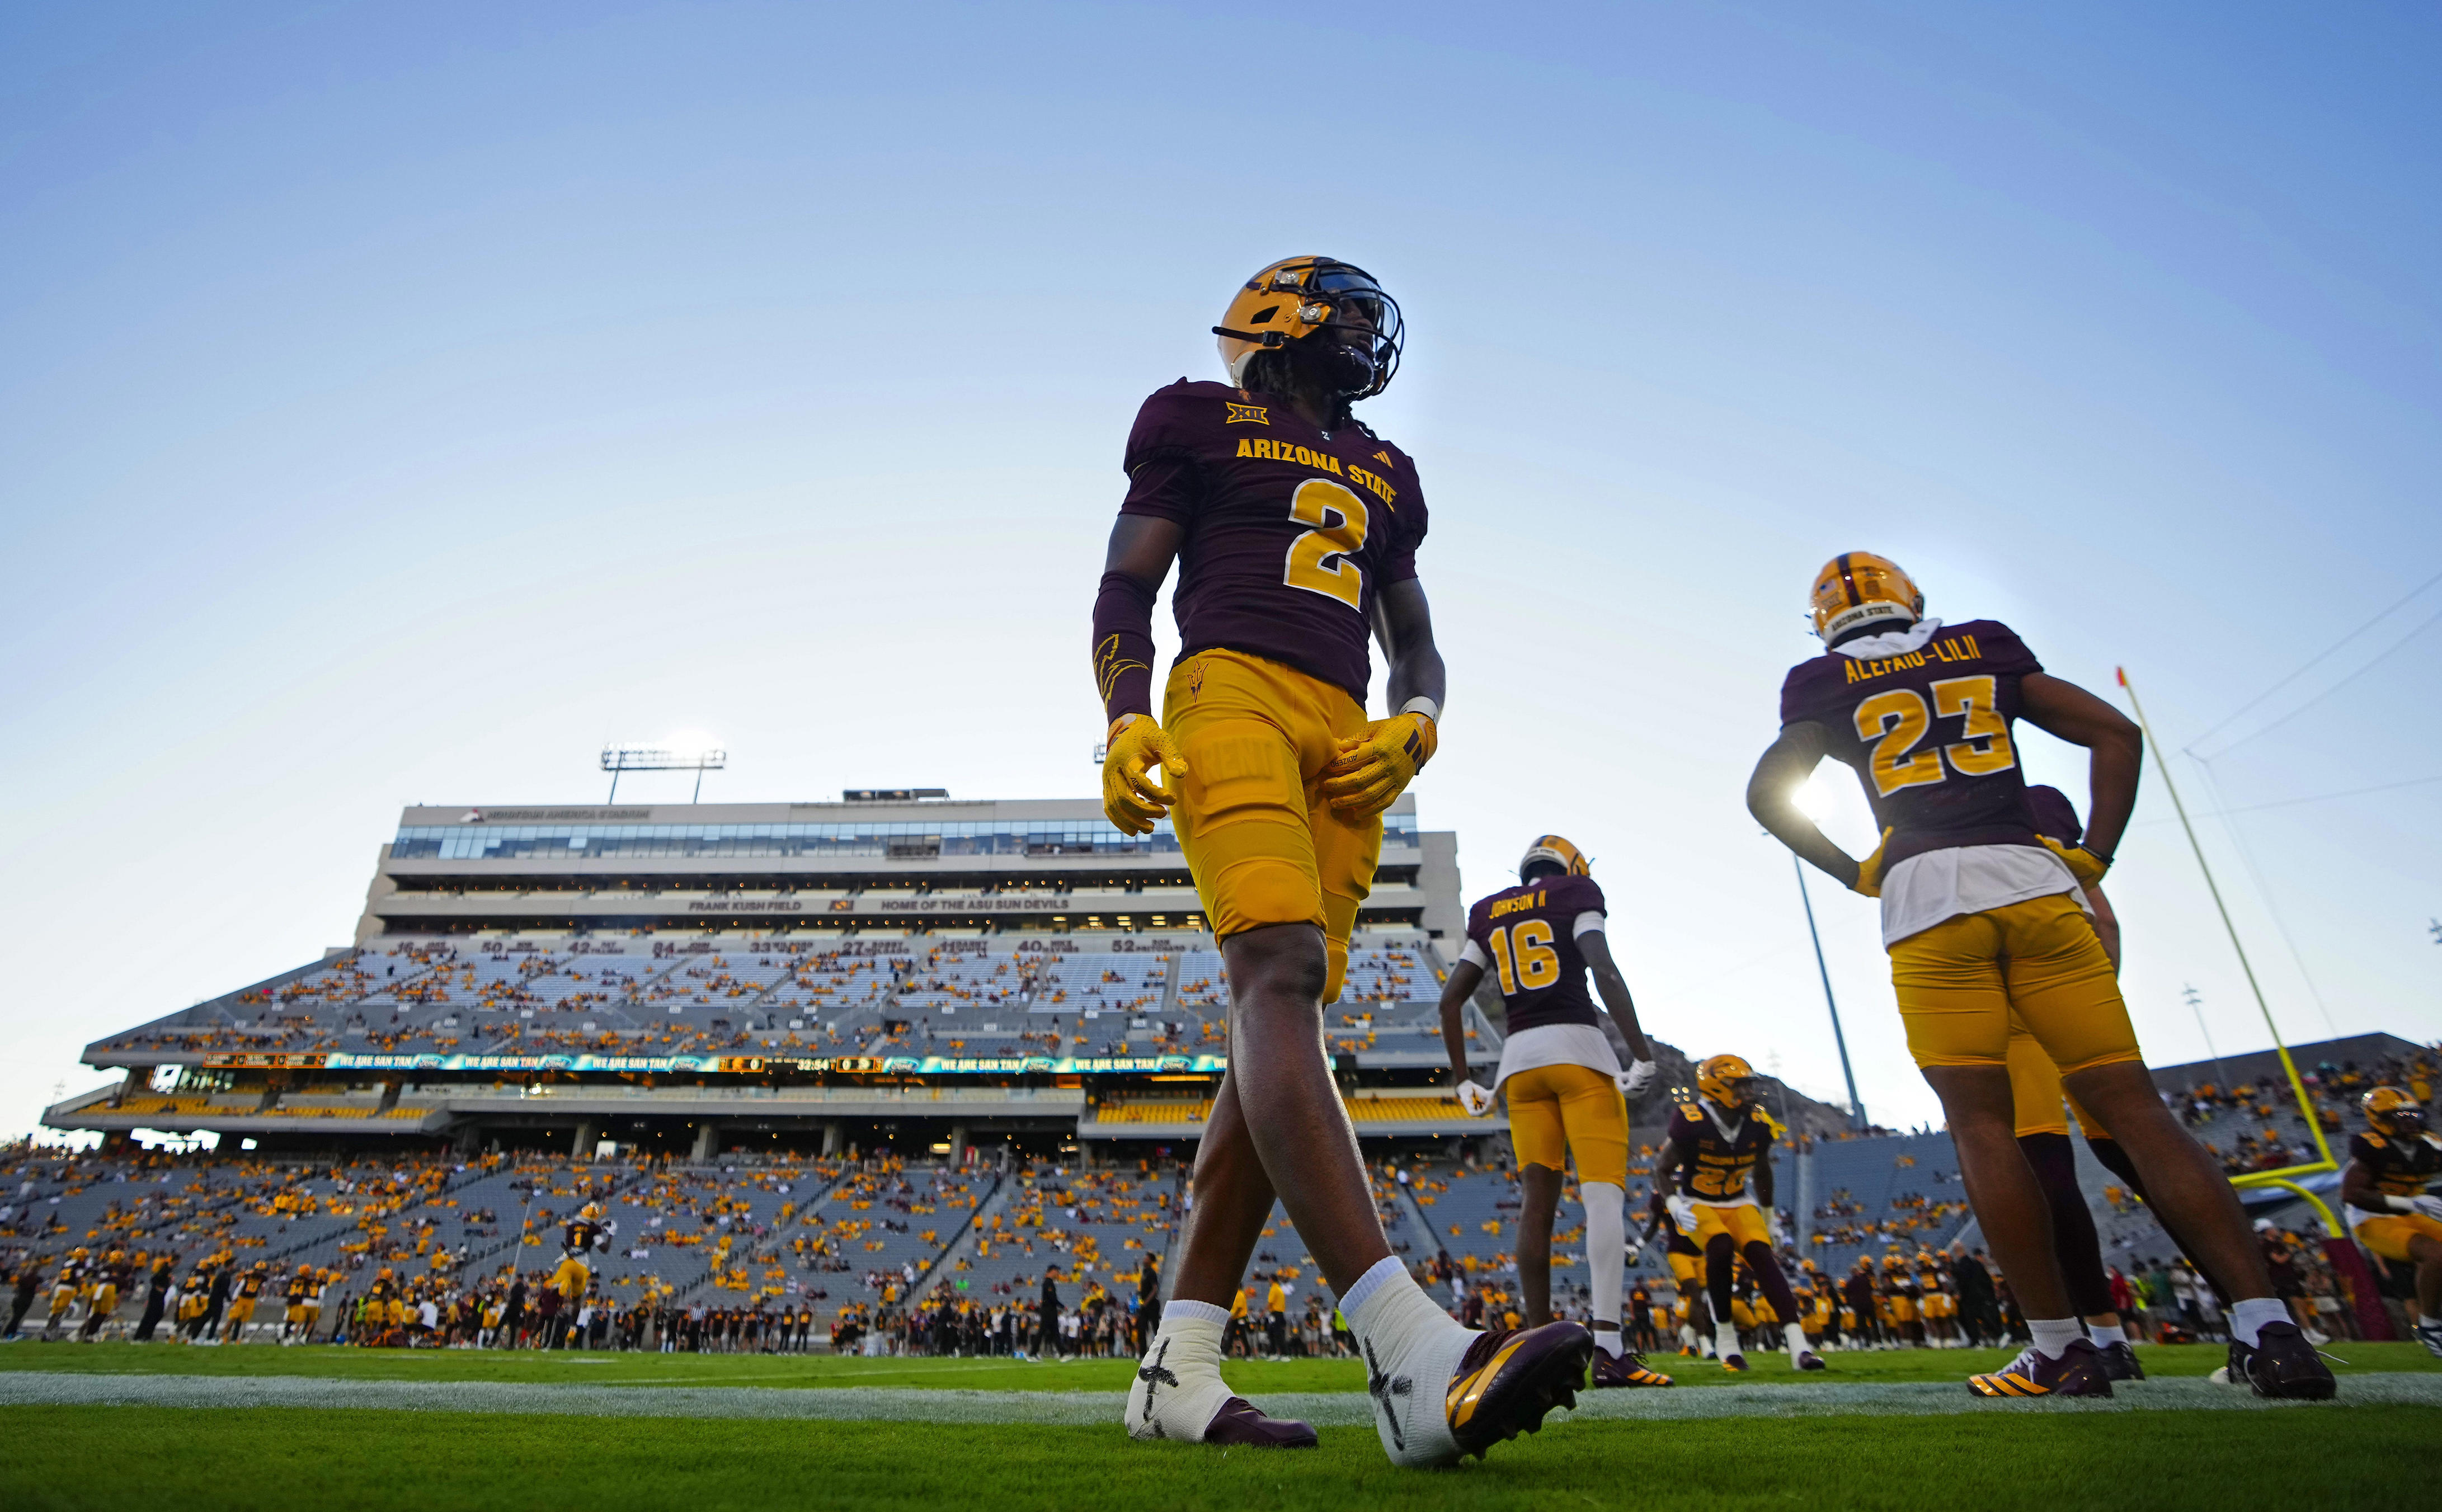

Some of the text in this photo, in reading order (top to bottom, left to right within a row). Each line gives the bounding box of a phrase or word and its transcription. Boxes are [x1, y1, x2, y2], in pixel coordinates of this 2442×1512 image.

[1228, 404, 1267, 423] XII
[1236, 438, 1398, 512] ARIZONA STATE
[1283, 478, 1370, 614] 2
[1832, 606, 1894, 631] ARIZONA STATE
[1853, 675, 2016, 798] 23
[1330, 753, 1358, 768] ADIZERO
[1130, 777, 1157, 801] ADIZERO
[487, 809, 650, 819] MOUNTAIN AMERICA STADIUM
[689, 901, 802, 911] FRANK KUSH FIELD
[881, 899, 1069, 911] HOME OF THE ASU SUN DEVILS
[1489, 892, 1535, 920] JOHNSON
[482, 942, 502, 953] 50
[567, 941, 590, 953] 42
[652, 941, 674, 953] 84
[749, 942, 770, 953] 33
[841, 941, 864, 954] 27
[1018, 940, 1042, 952] 40
[1112, 940, 1134, 952] 52
[1488, 918, 1561, 996] 16
[340, 1055, 355, 1066] WE
[355, 1055, 374, 1066] ARE
[374, 1055, 393, 1066] SAN
[394, 1055, 413, 1066] TAN
[465, 1056, 481, 1067] WE
[480, 1056, 500, 1067] ARE
[500, 1056, 519, 1067] SAN
[520, 1056, 539, 1067] TAN
[592, 1057, 608, 1068] WE
[608, 1057, 628, 1068] ARE
[628, 1057, 648, 1068] SAN
[648, 1057, 668, 1068] TAN
[750, 1058, 760, 1070] 0
[797, 1058, 830, 1071] 32:54
[842, 1058, 851, 1071] 0
[941, 1059, 957, 1071] WE
[957, 1059, 977, 1071] ARE
[978, 1059, 999, 1071] SAN
[999, 1059, 1020, 1071] TAN
[1074, 1058, 1092, 1070] WE
[1092, 1058, 1112, 1070] ARE
[1113, 1058, 1134, 1070] SAN
[1134, 1058, 1156, 1070] TAN
